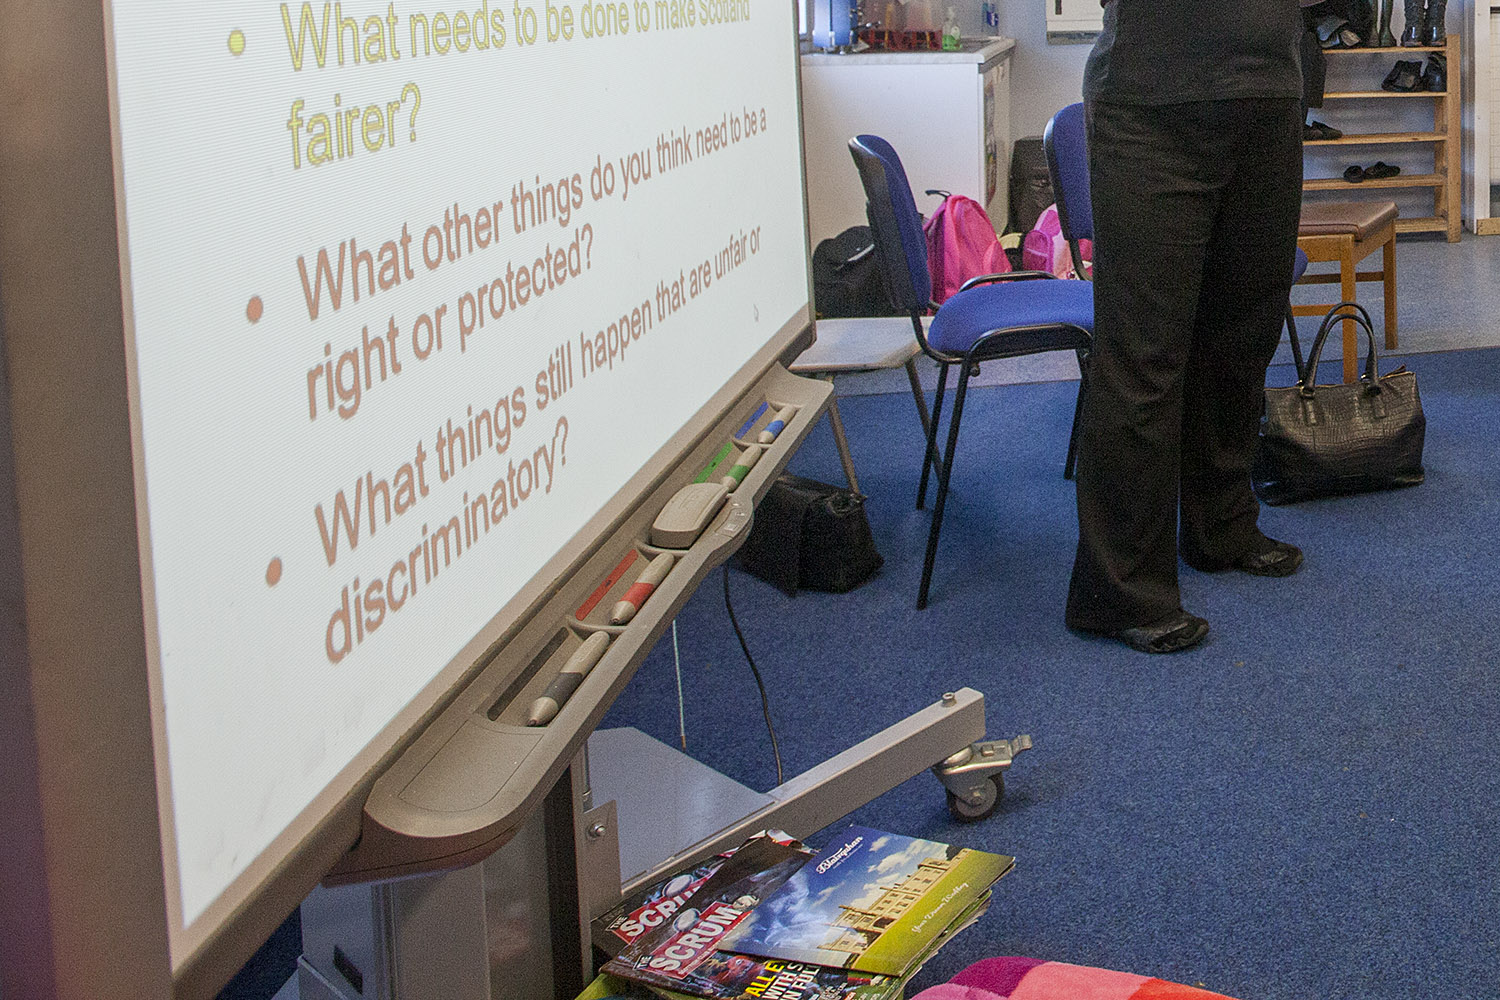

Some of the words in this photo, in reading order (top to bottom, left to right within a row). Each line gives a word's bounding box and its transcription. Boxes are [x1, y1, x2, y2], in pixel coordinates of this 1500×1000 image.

[280, 0, 400, 72] What
[287, 81, 422, 170] fairer?
[296, 221, 414, 321] What
[422, 202, 503, 271] other
[511, 174, 583, 234] things
[590, 154, 615, 201] do
[620, 147, 651, 201] you
[656, 125, 692, 174] think
[696, 112, 727, 159] need
[730, 111, 741, 144] to
[744, 105, 757, 139] be
[760, 107, 767, 132] a
[307, 315, 402, 422] right
[412, 303, 447, 361] or
[458, 222, 593, 354] protected?
[314, 440, 429, 567] What
[436, 386, 527, 484] things
[535, 340, 573, 411] still
[580, 299, 652, 378] happen
[656, 269, 686, 323] that
[689, 259, 712, 299] are
[714, 229, 747, 280] unfair
[750, 225, 761, 255] or
[325, 416, 569, 665] discriminatory?
[650, 906, 743, 972] SCRUM
[745, 975, 776, 997] ALL
[762, 970, 798, 1000] WITH
